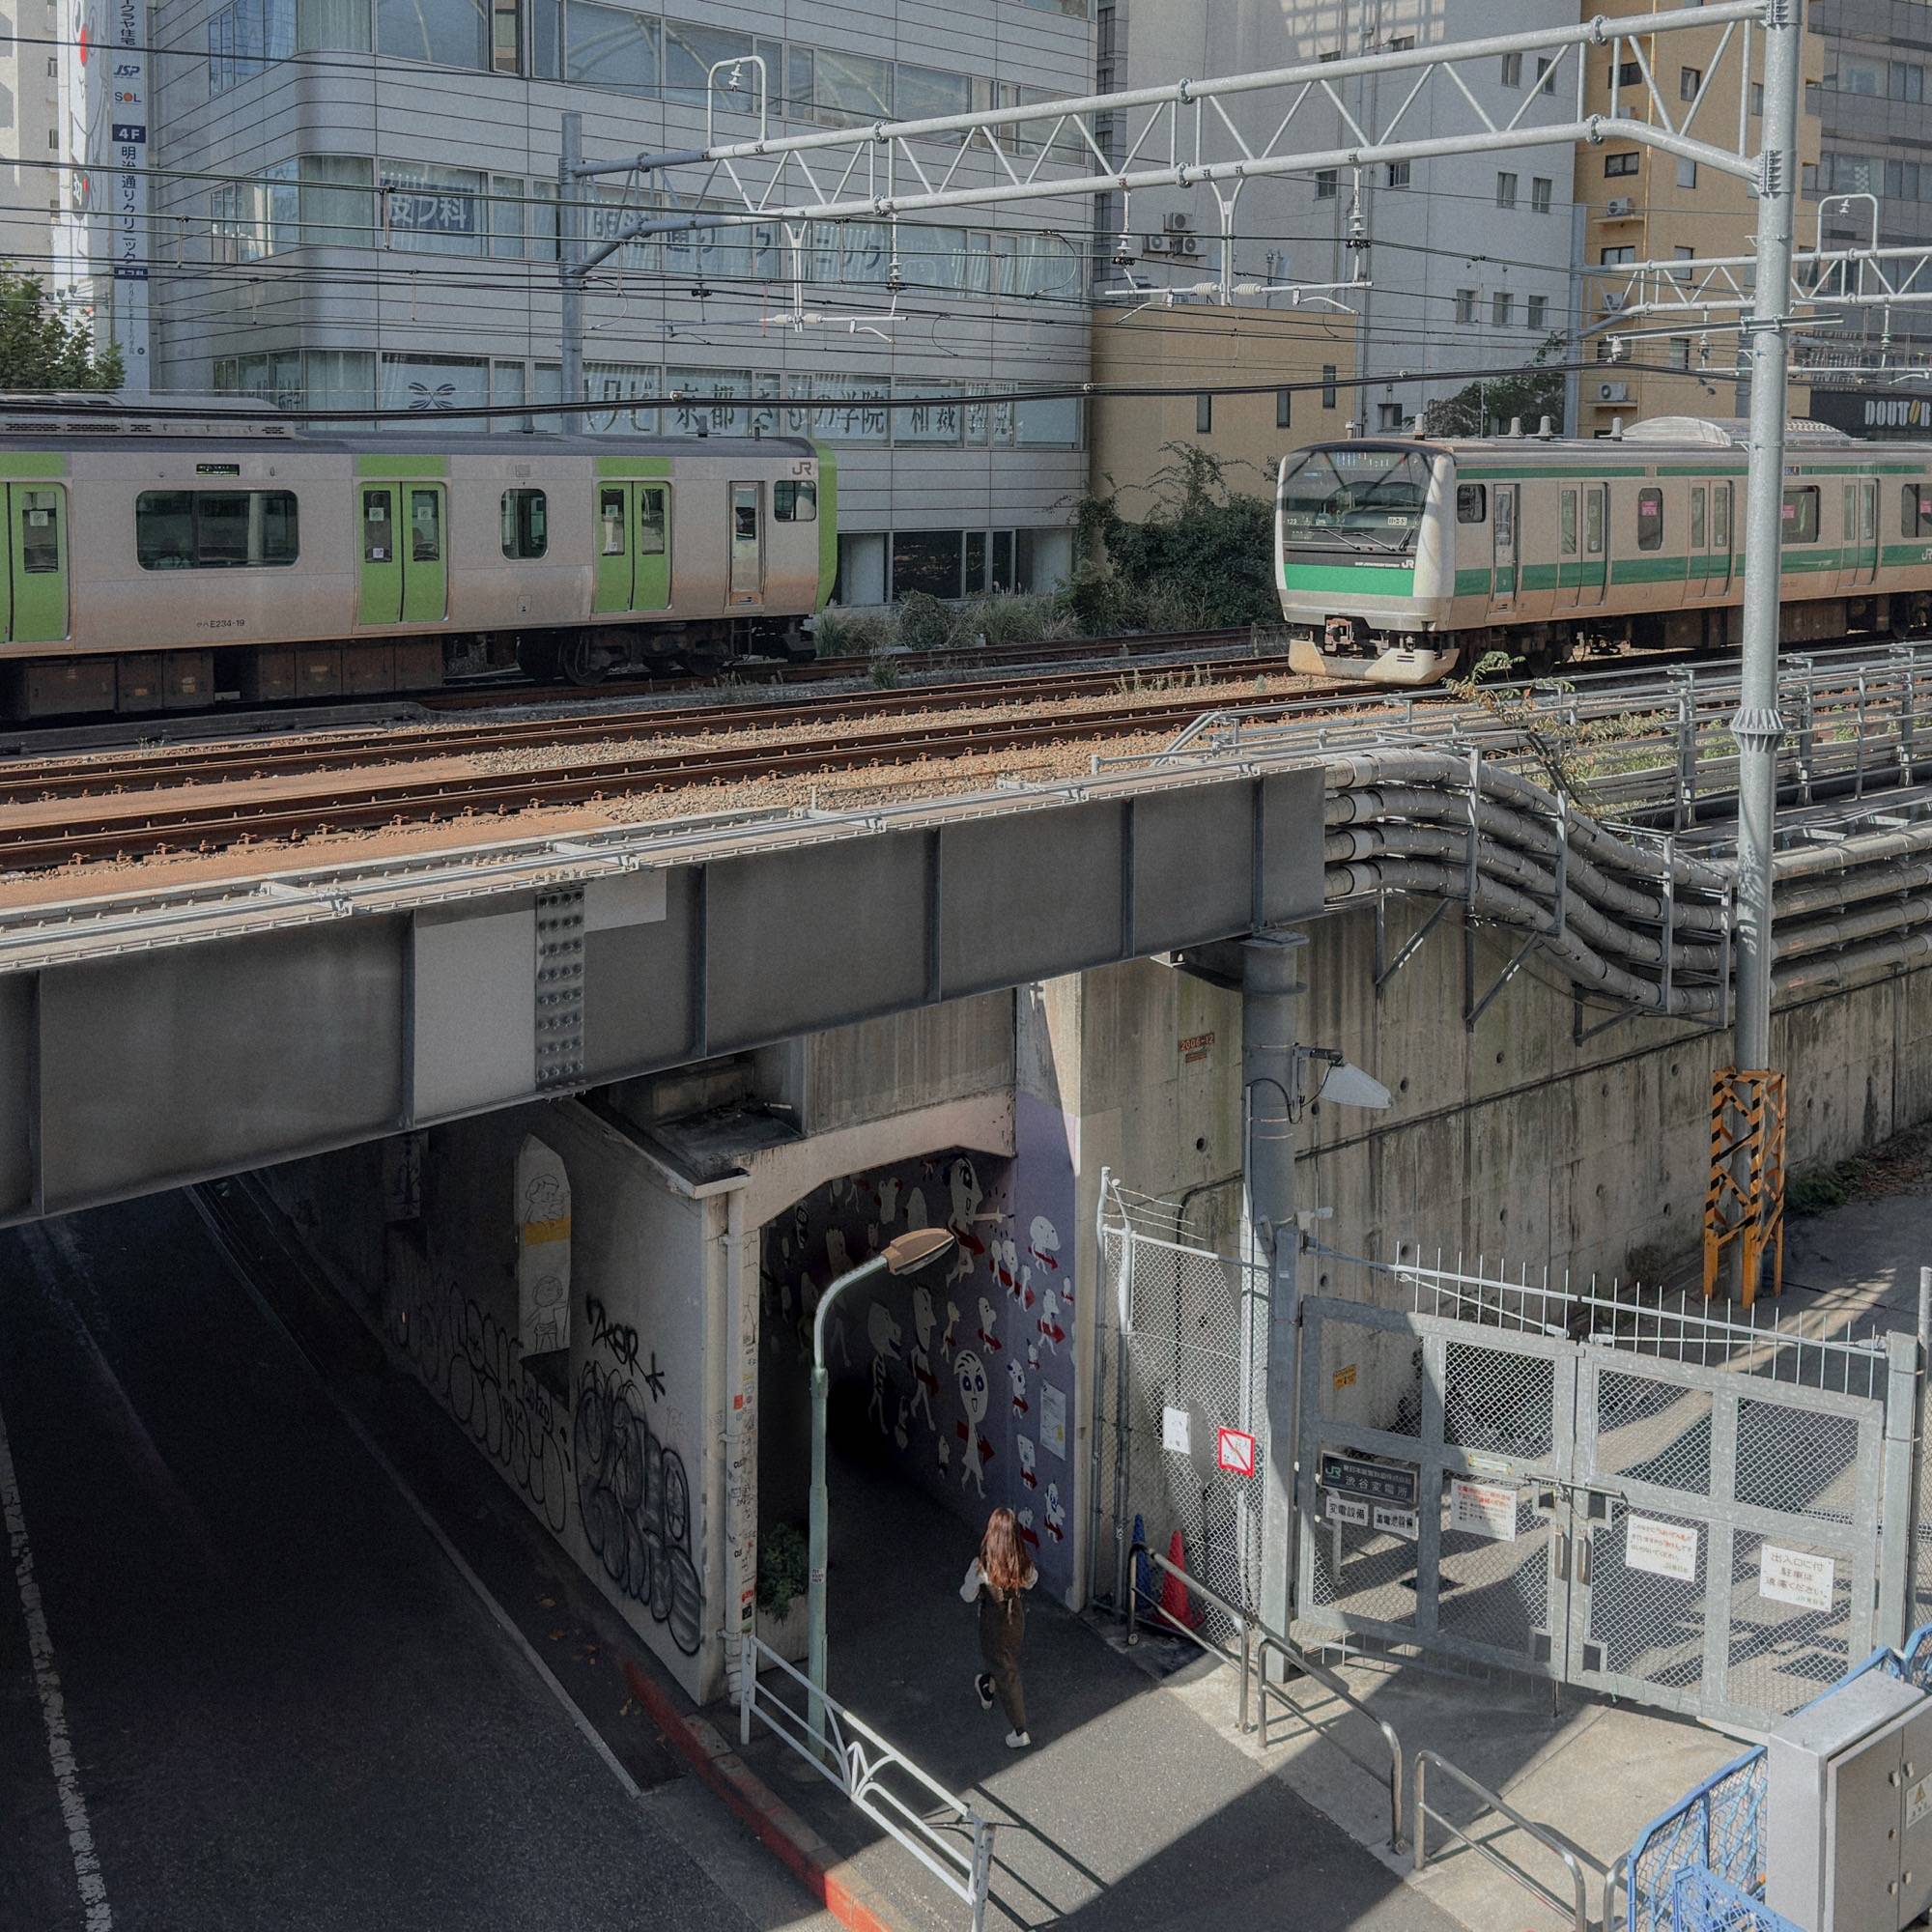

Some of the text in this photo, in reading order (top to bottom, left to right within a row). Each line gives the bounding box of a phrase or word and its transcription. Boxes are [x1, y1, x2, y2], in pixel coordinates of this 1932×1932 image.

[121, 0, 136, 45] クラヤ住宅
[113, 64, 140, 76] JSP
[114, 92, 142, 103] SOL
[118, 128, 141, 140] 4F
[1864, 398, 1931, 427] DOUTOR
[792, 461, 811, 475] JR
[1401, 559, 1414, 569] JR
[1325, 1465, 1342, 1479] JR
[1346, 1475, 1407, 1498] 渋谷変電所
